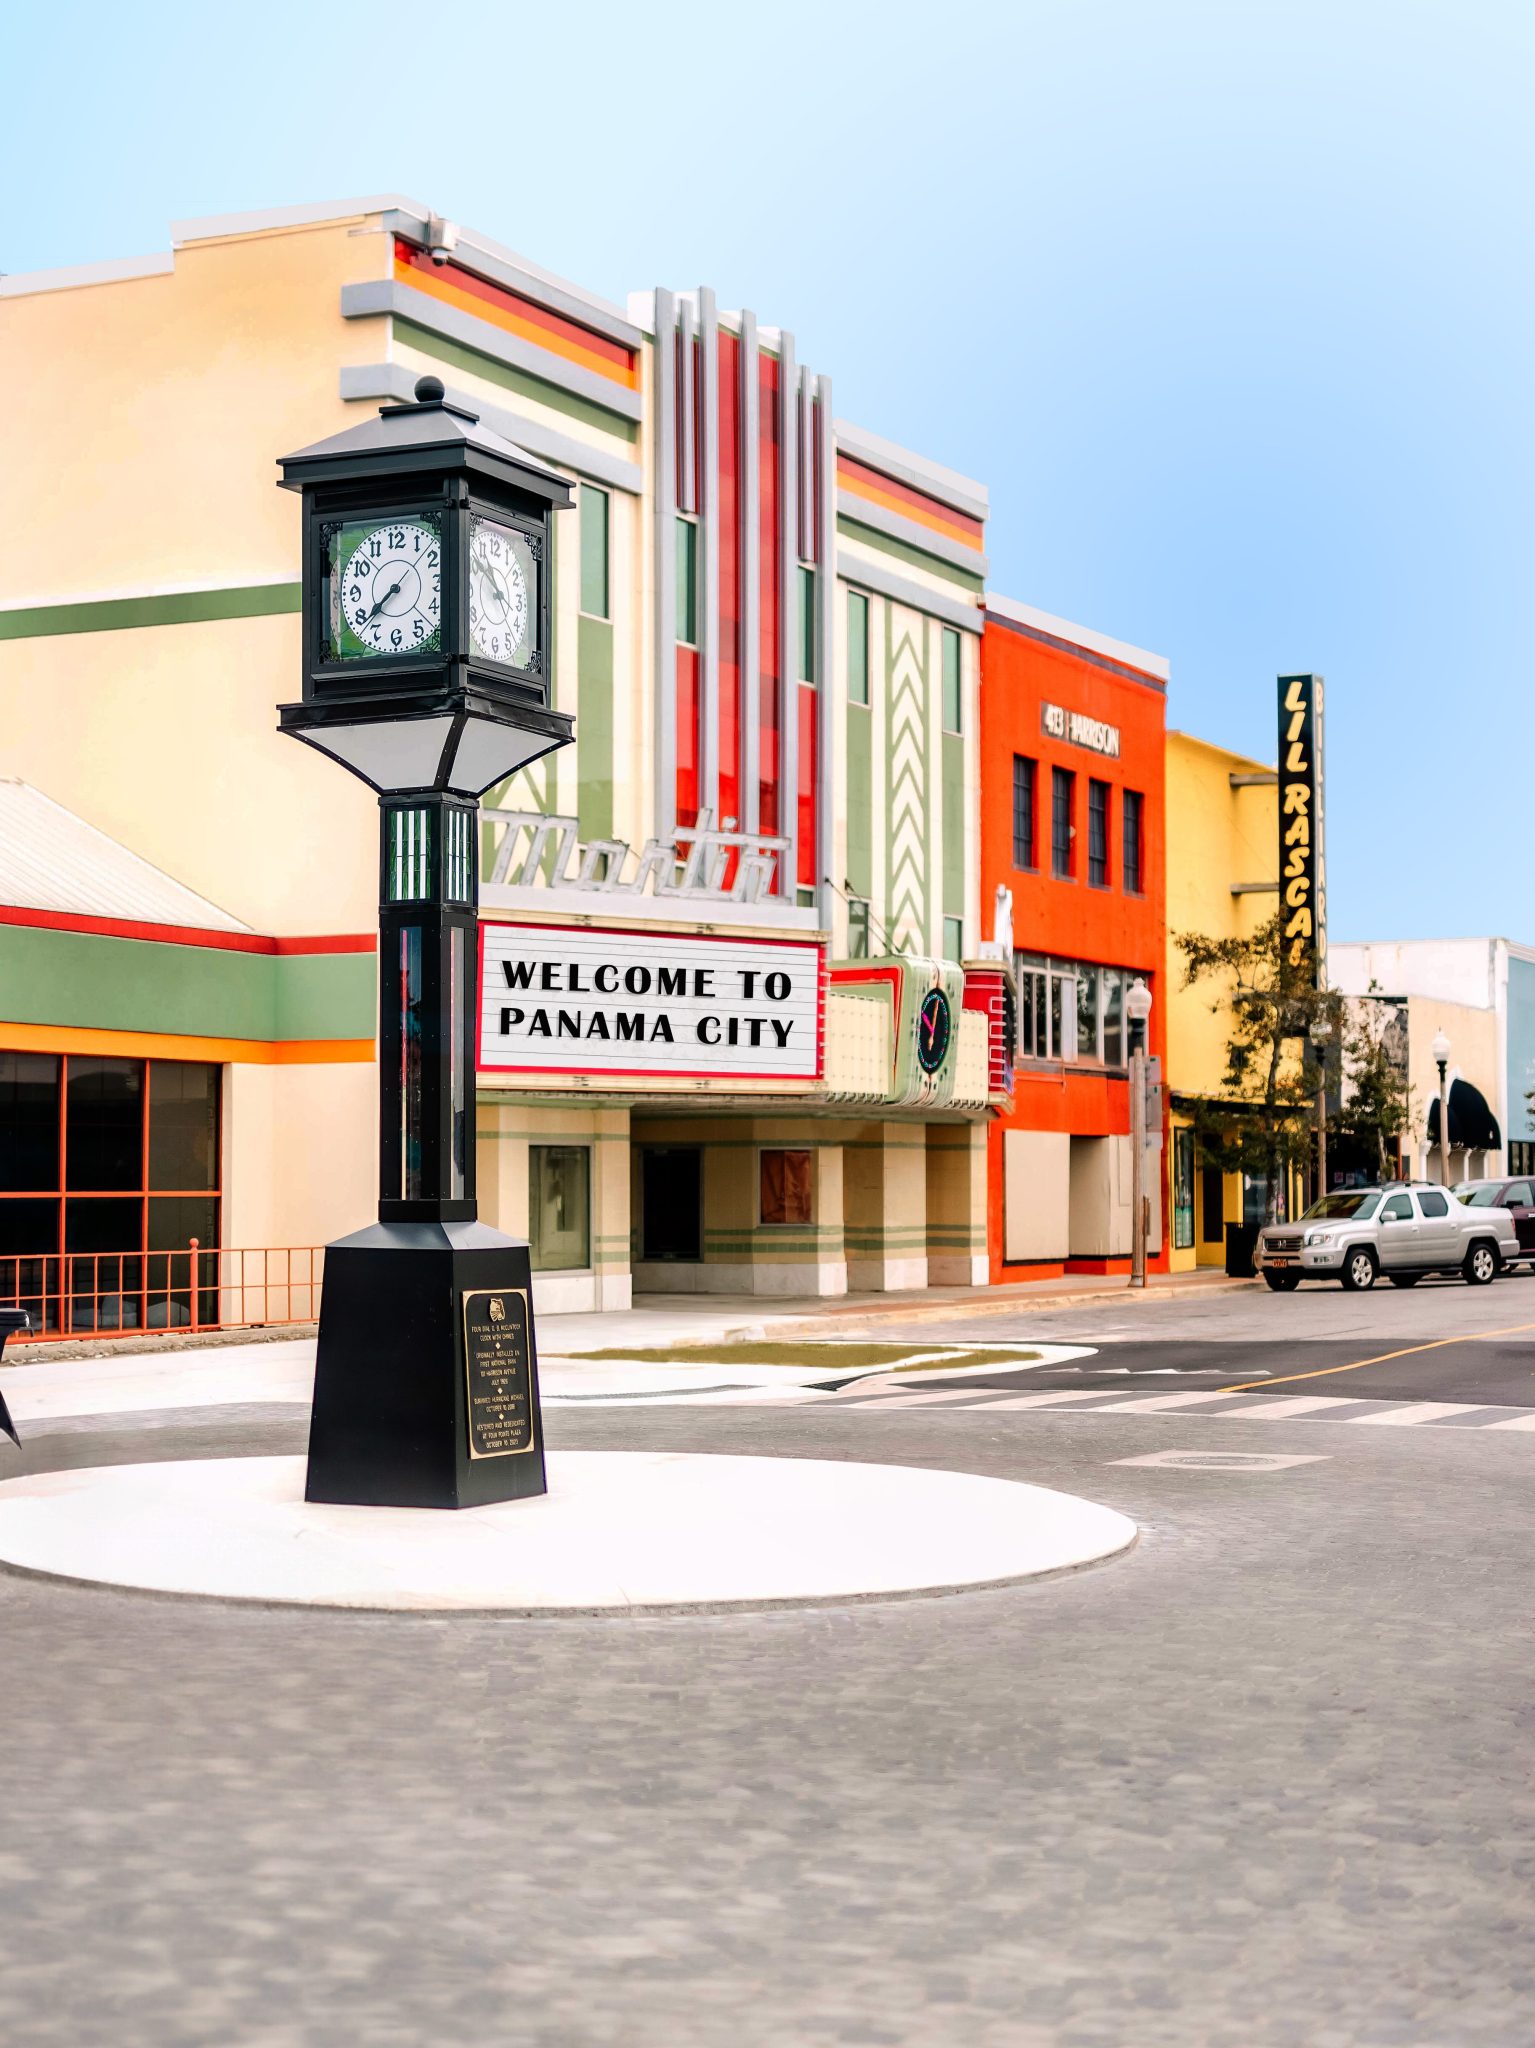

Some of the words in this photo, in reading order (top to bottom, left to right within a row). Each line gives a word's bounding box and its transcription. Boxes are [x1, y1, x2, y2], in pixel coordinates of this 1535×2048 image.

[370, 540, 382, 558] 11
[388, 532, 406, 550] 12
[414, 534, 420, 552] 1
[490, 537, 500, 558] 12
[427, 550, 440, 568] 2
[479, 541, 487, 560] 11
[504, 548, 510, 566] 1
[354, 560, 370, 578] 10
[512, 569, 520, 587] 2
[350, 584, 362, 602] 9
[428, 597, 440, 616] 4
[516, 594, 522, 612] 3
[355, 608, 367, 626] 8
[514, 615, 520, 633] 4
[370, 624, 382, 642] 7
[390, 628, 402, 647] 6
[412, 619, 424, 638] 5
[479, 627, 486, 645] 7
[491, 636, 499, 654] 6
[504, 632, 512, 650] 5
[1066, 710, 1120, 757] HARRISON
[1284, 681, 1308, 772] LIL
[502, 960, 716, 998] WELCOME
[737, 970, 792, 1000] TO
[500, 1007, 675, 1043] PANAMA
[696, 1016, 794, 1048] CITY
